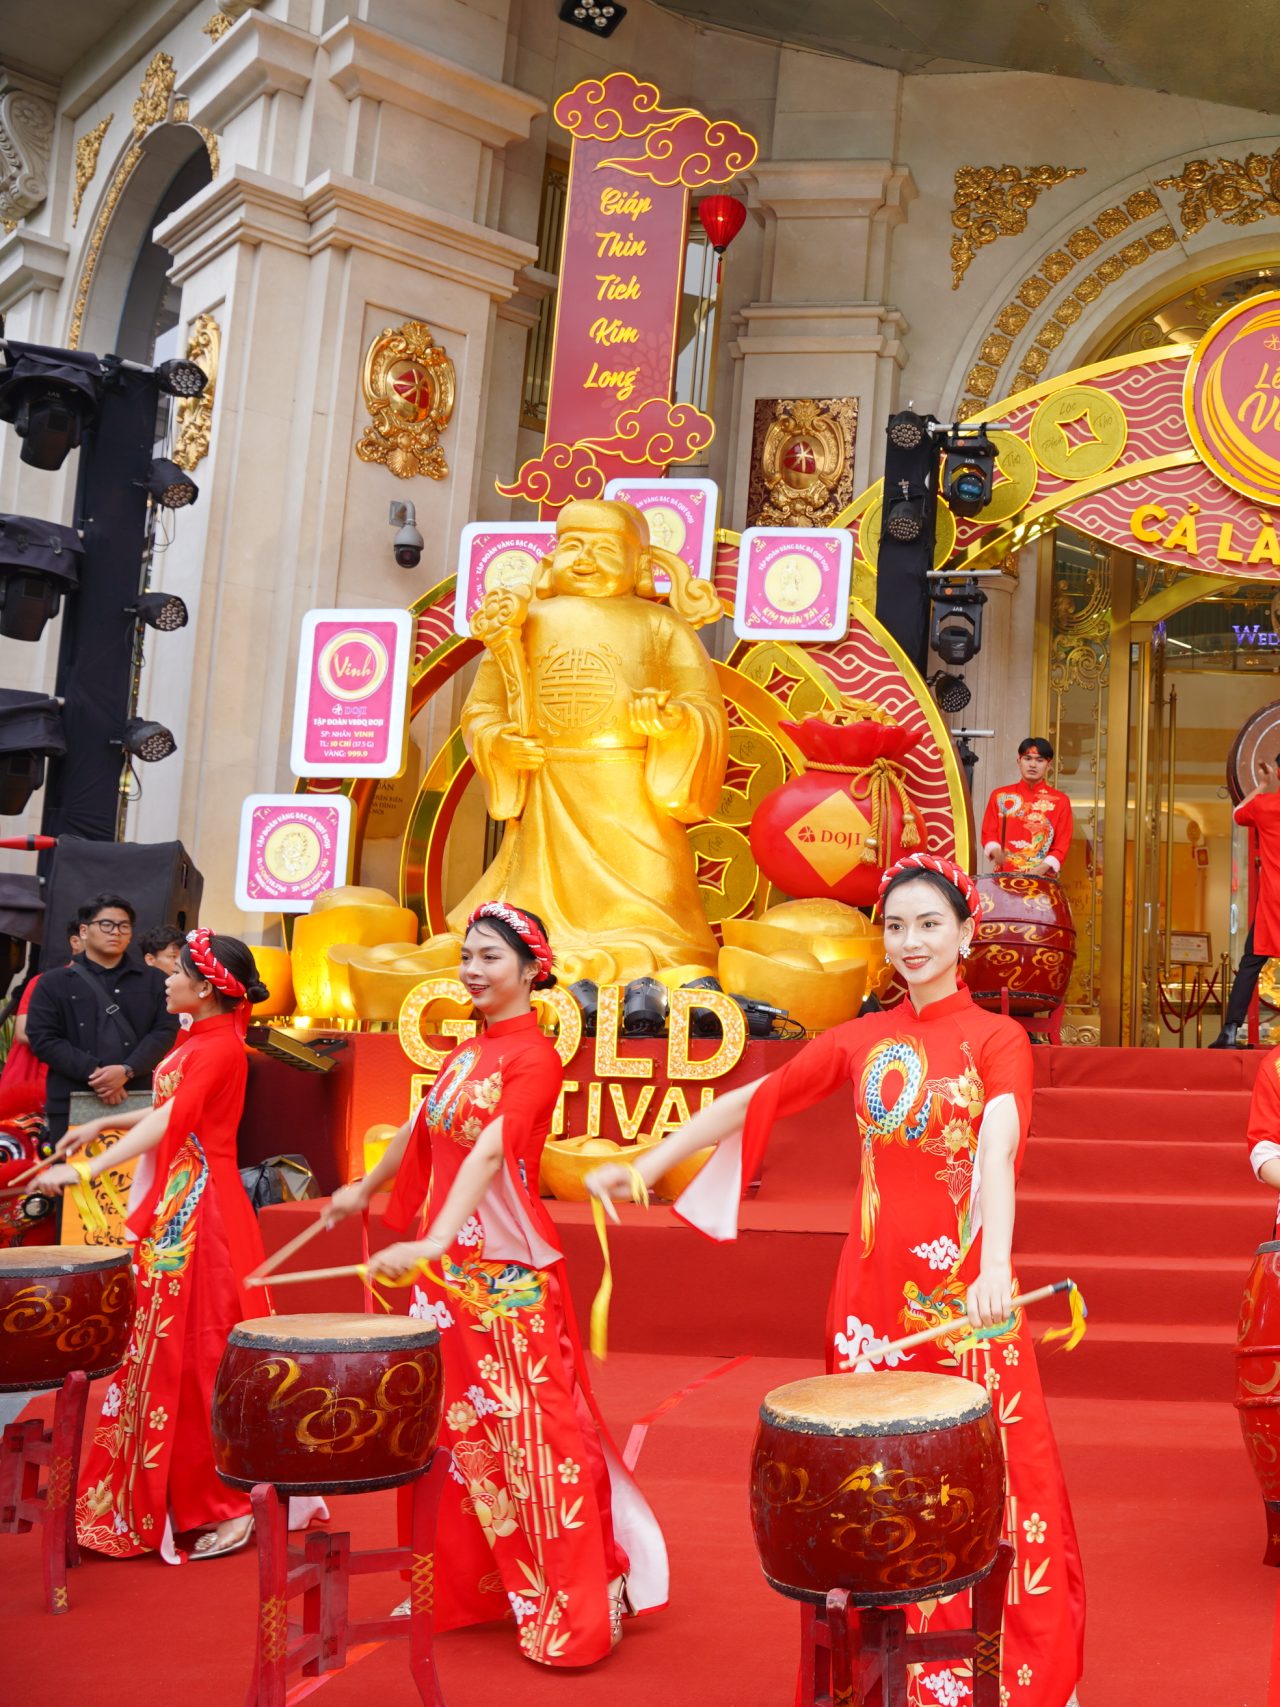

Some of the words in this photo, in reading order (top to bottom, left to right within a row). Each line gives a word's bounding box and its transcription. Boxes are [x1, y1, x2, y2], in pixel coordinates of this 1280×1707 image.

[600, 187, 653, 222] Giáp
[595, 231, 647, 258] Thìn
[595, 273, 641, 301] Tích
[588, 317, 640, 347] Kim
[583, 362, 641, 402] Long
[1130, 502, 1200, 556] CẢ
[334, 652, 373, 678] Vinh
[821, 830, 861, 850] DOJI
